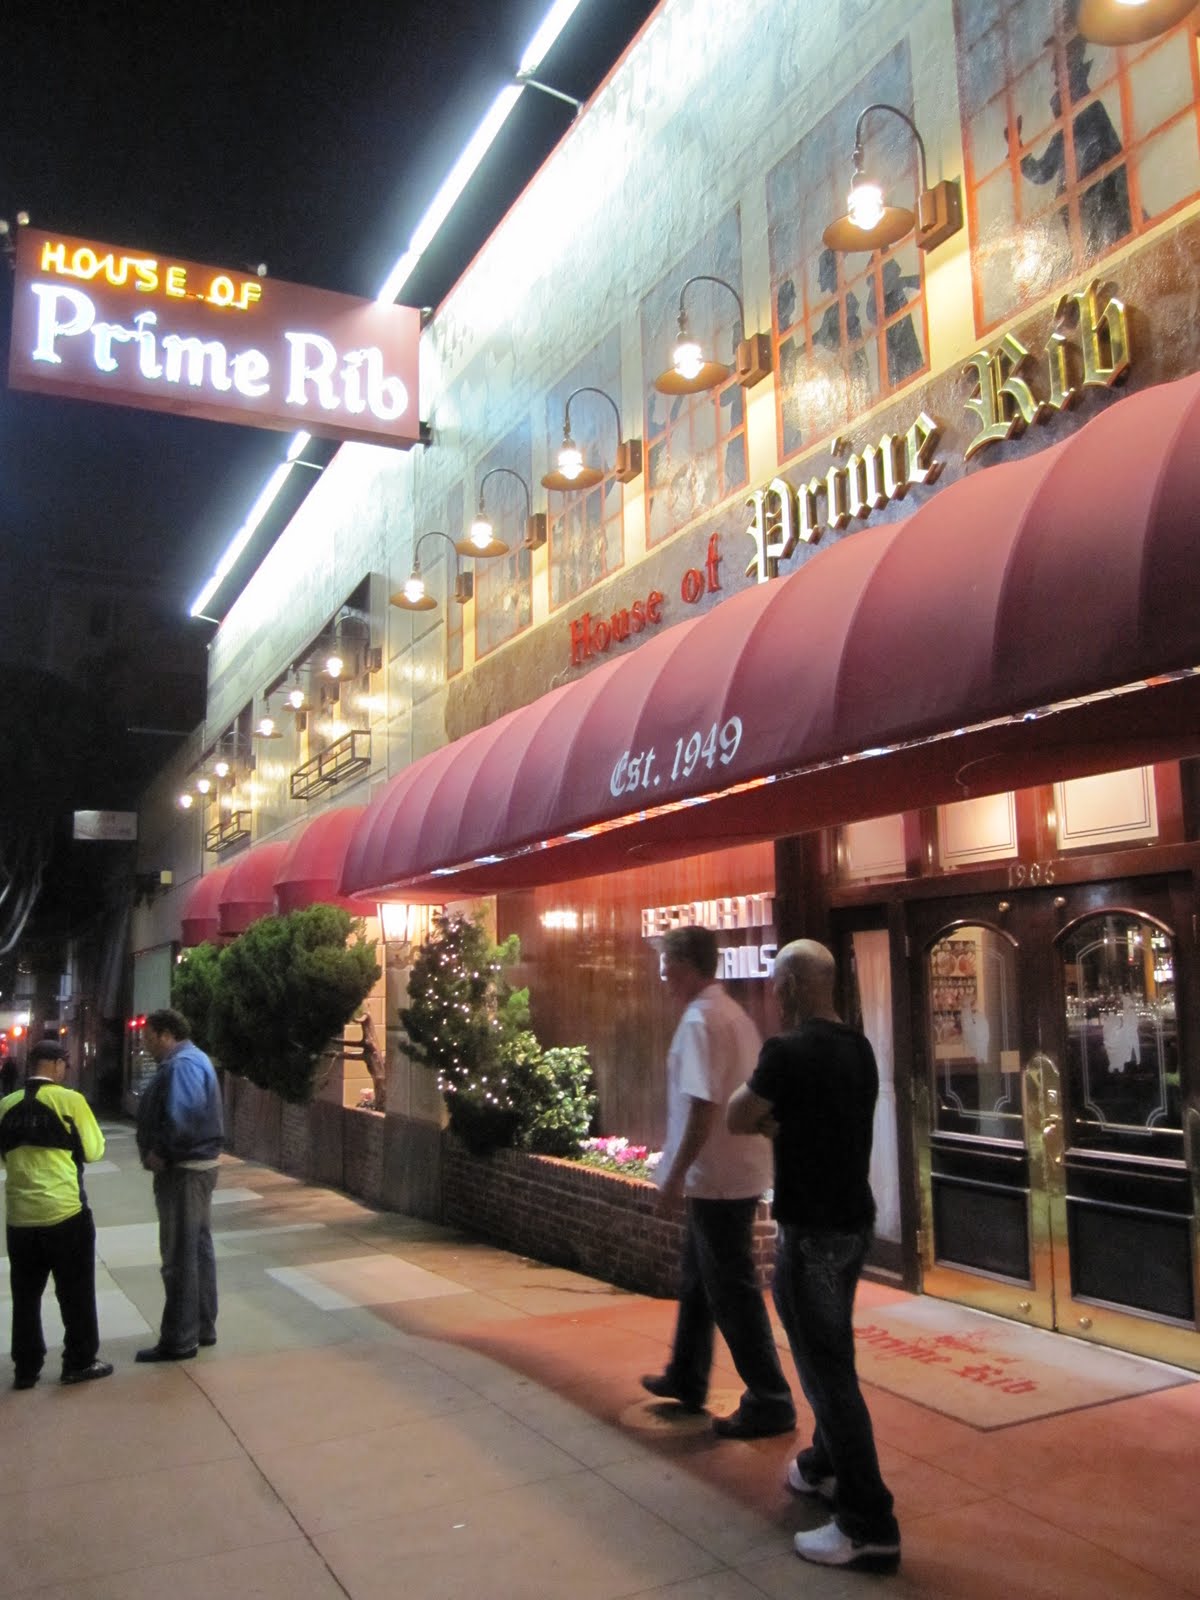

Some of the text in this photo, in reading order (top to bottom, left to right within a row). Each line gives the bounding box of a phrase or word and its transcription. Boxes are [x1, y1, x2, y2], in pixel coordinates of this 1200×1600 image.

[40, 241, 263, 311] HOUSE OF
[31, 283, 409, 420] Prime Rib
[569, 279, 1131, 667] House of Prime Rib
[610, 715, 743, 797] Est. 1949
[1007, 860, 1055, 888] 1906
